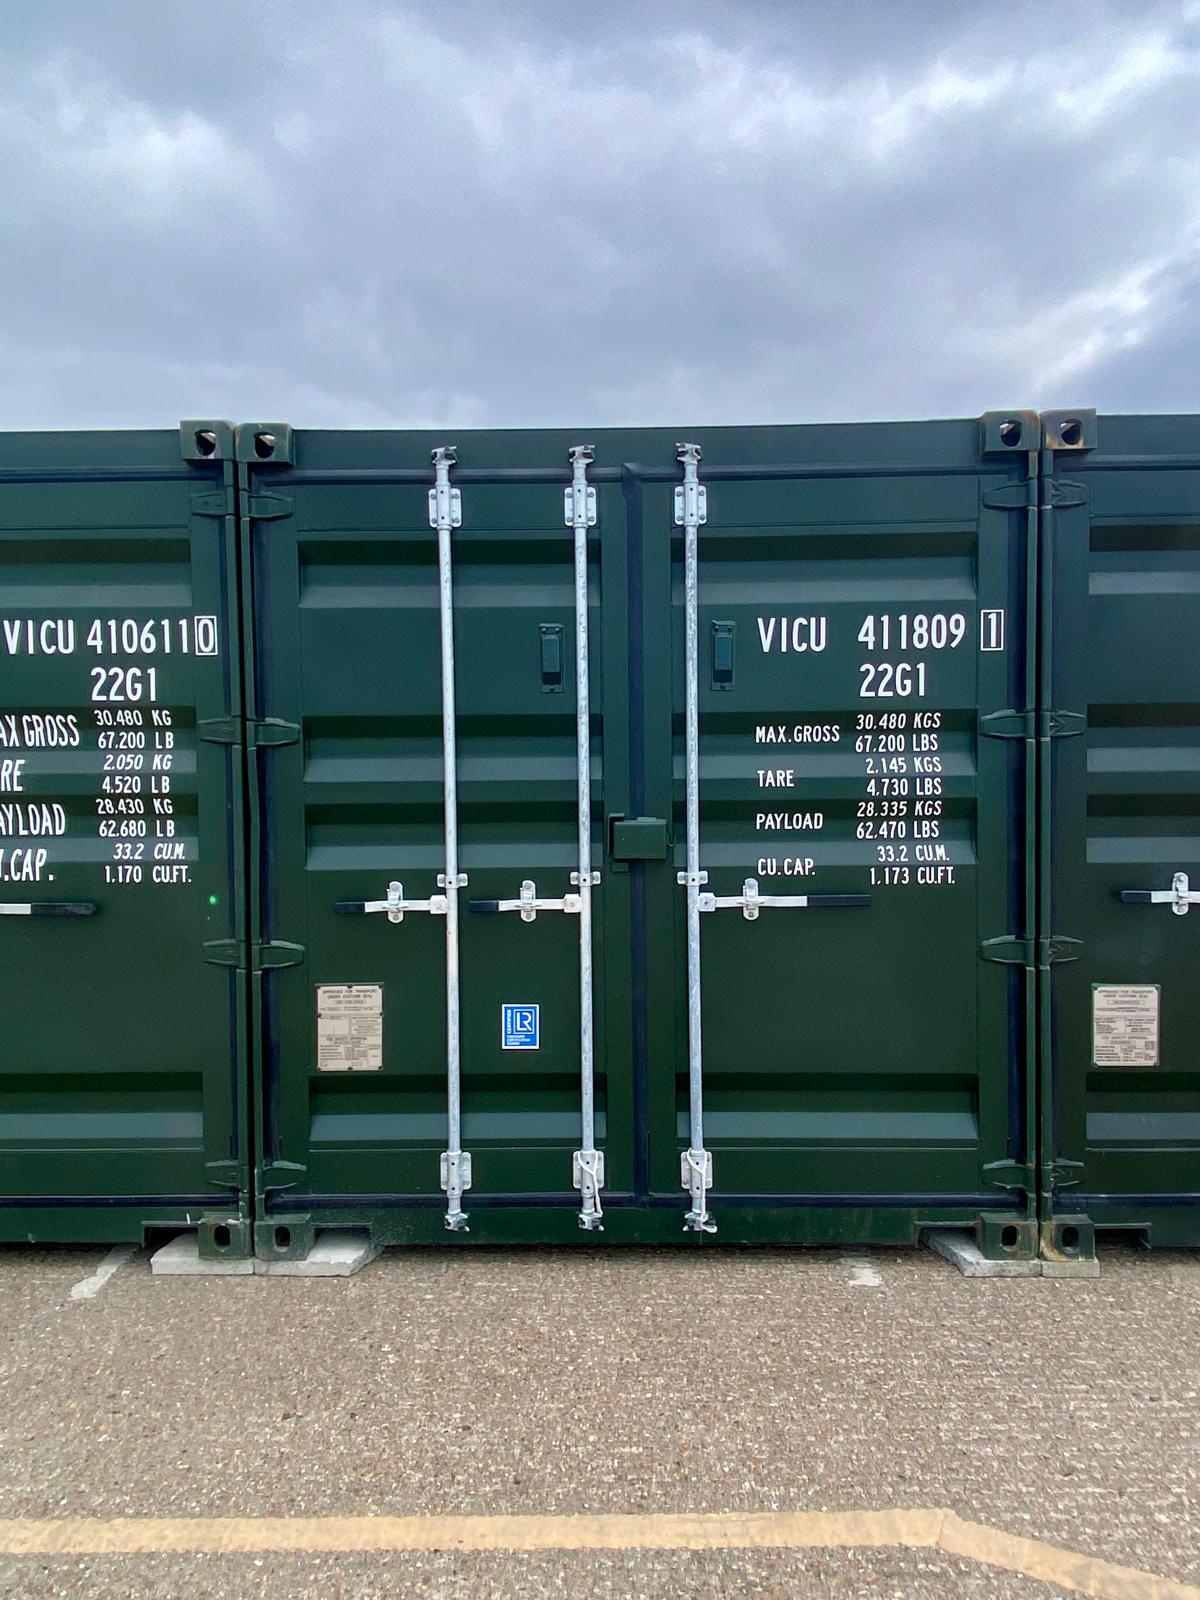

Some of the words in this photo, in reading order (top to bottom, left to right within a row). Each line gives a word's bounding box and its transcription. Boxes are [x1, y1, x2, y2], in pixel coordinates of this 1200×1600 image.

[4, 620, 74, 654] VICU
[758, 617, 825, 652] VICU
[858, 614, 965, 649] 411809
[91, 667, 155, 701] 22G1
[860, 663, 924, 696] 22G1
[152, 710, 171, 725] KG
[914, 713, 940, 728] KGS
[0, 715, 19, 746] AX
[23, 715, 79, 746] GROSS
[756, 726, 839, 742] MAX.GROSS
[156, 732, 173, 748] LB
[913, 734, 937, 751] LBS
[153, 754, 172, 770] KG
[914, 757, 941, 772] KGS
[1, 760, 25, 791] RE
[757, 770, 794, 787] TARE
[152, 776, 169, 793] LB
[917, 778, 941, 795] LBS
[153, 799, 172, 813] KG
[915, 801, 941, 815] KGS
[157, 820, 174, 837] LB
[757, 813, 822, 829] PAYLOAD
[914, 821, 939, 838] LBS
[113, 843, 144, 859] 33.2
[154, 843, 185, 859] CU.M.
[877, 846, 908, 861] 33.2
[916, 845, 949, 861] CU.M.
[0, 849, 53, 881] .CAP.
[758, 858, 815, 875] CU.CAP.
[153, 866, 191, 882] CU.FT.
[918, 867, 955, 883] CU.FT.
[517, 1012, 533, 1031] LR
